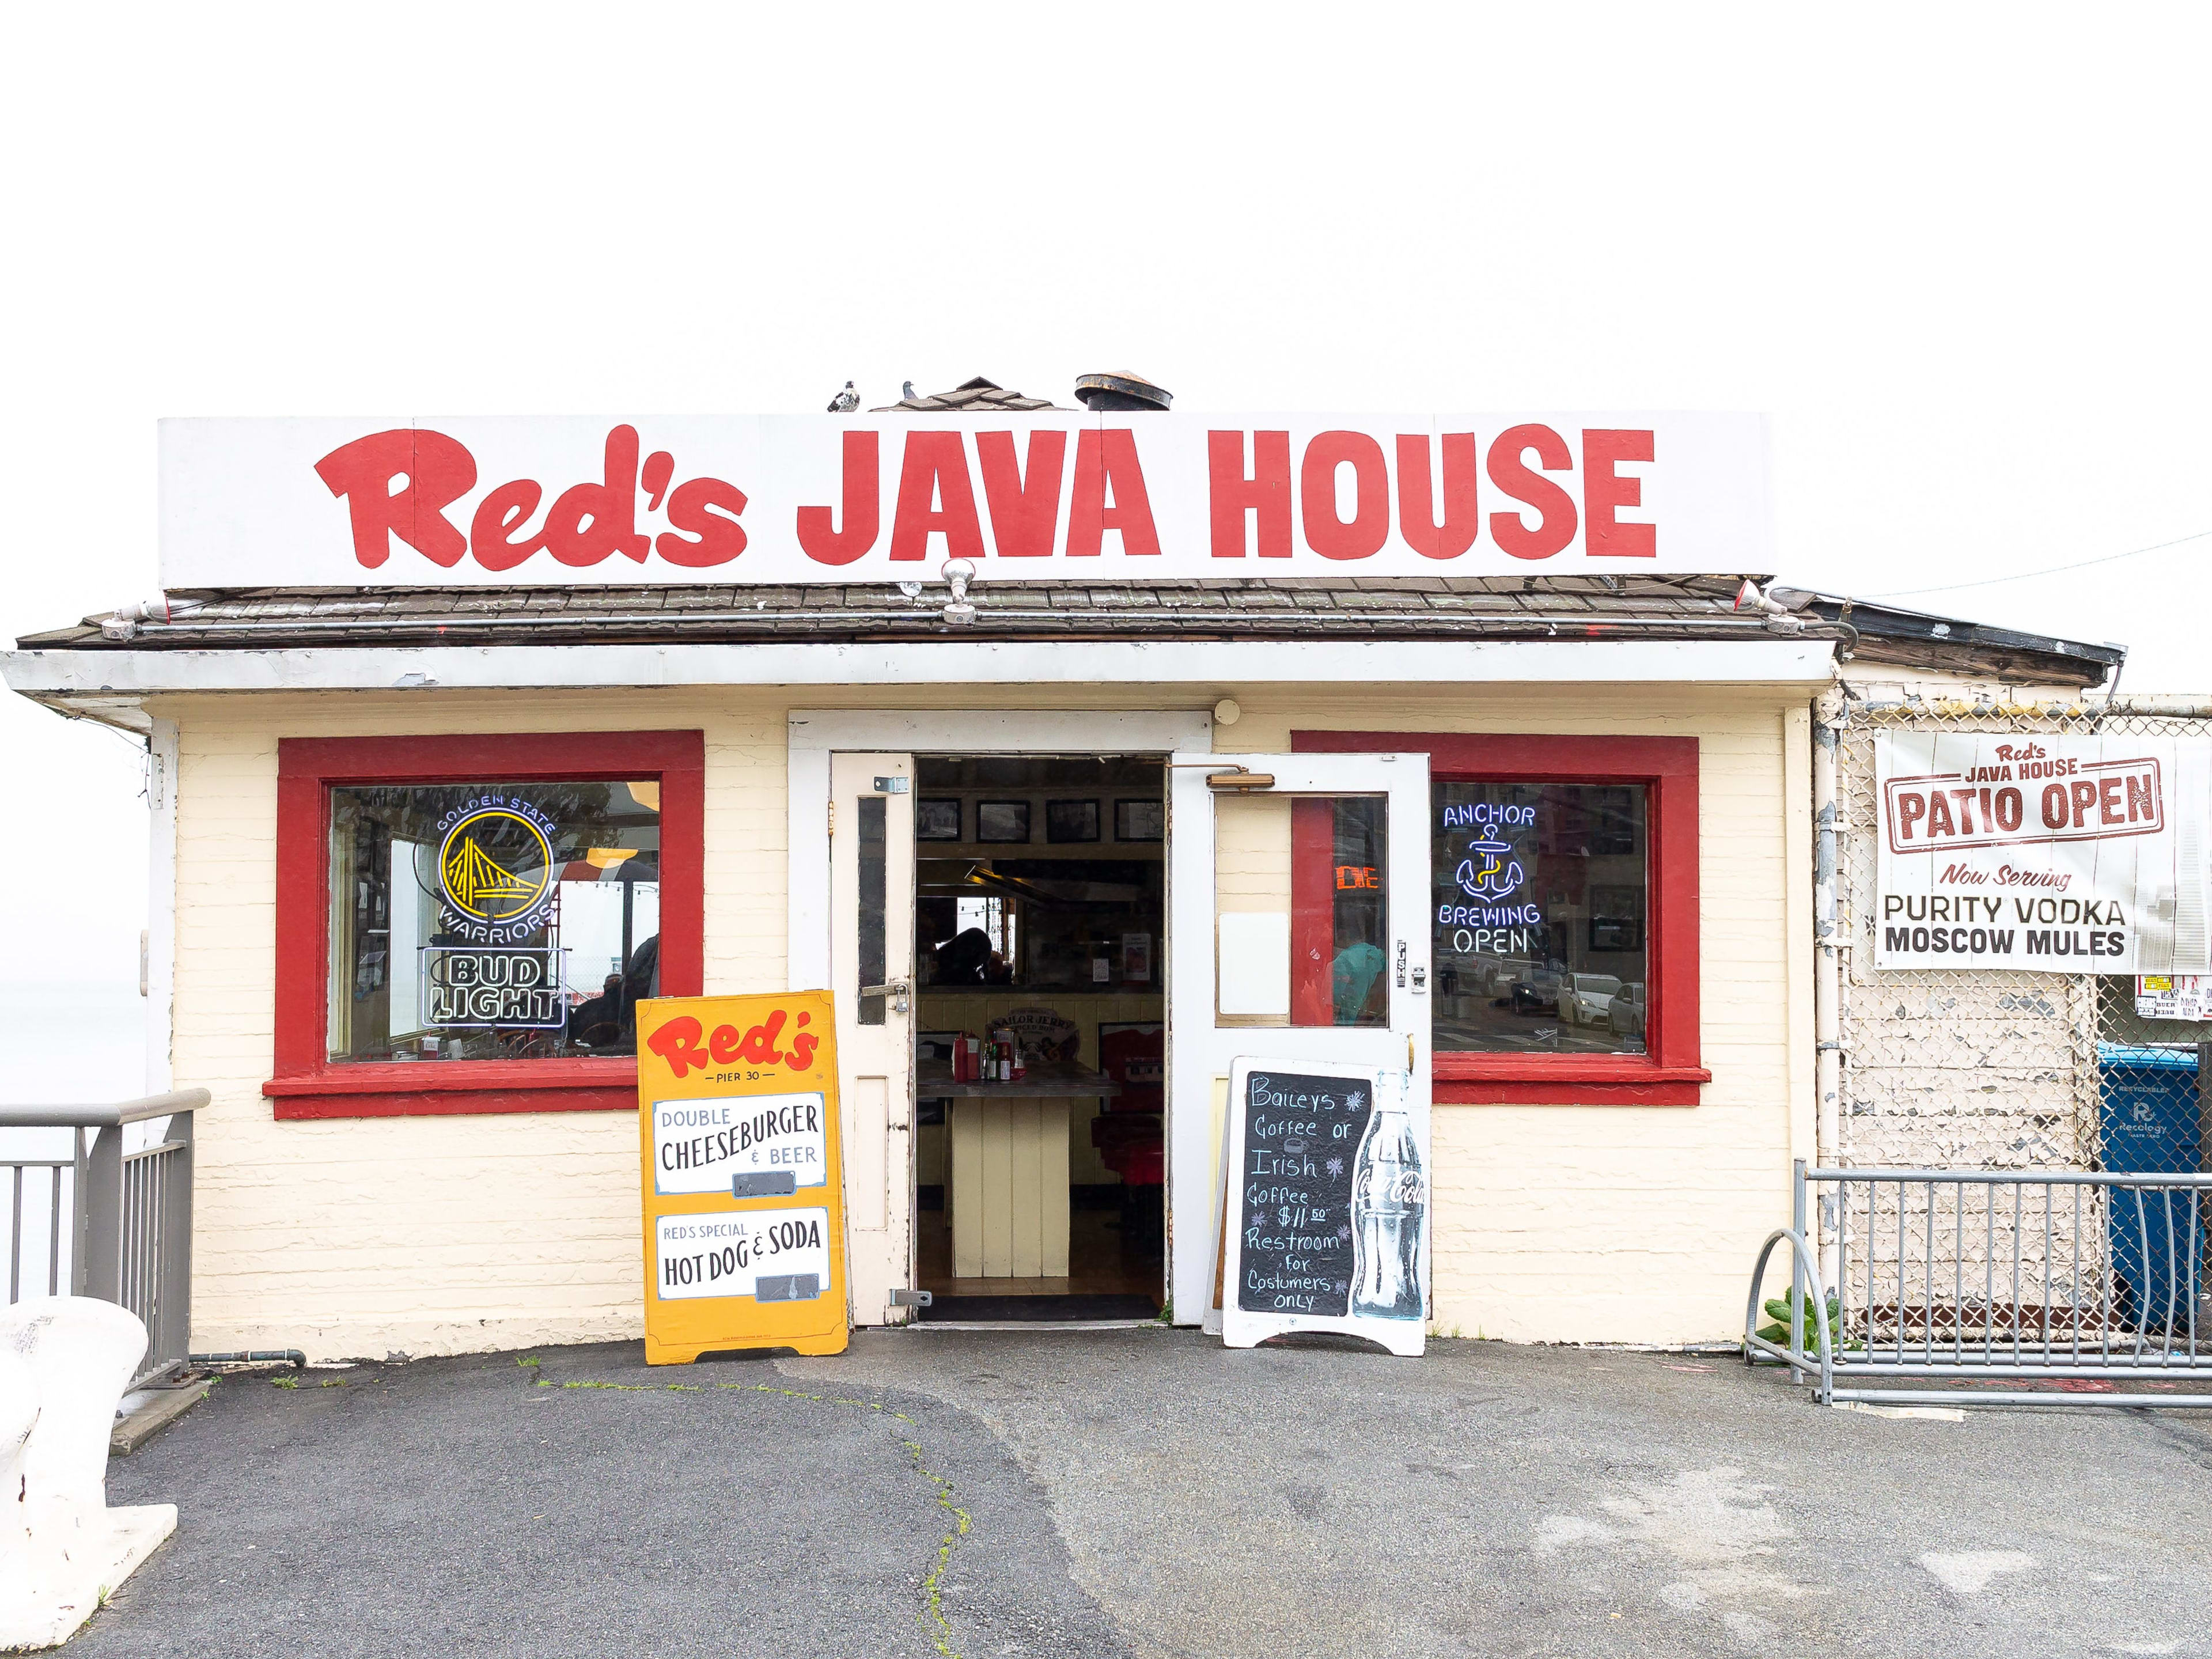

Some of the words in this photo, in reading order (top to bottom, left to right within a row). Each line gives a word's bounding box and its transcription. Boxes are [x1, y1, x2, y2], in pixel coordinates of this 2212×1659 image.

[314, 424, 748, 571] Red's
[797, 430, 1161, 565] JAVA
[1208, 424, 1656, 559] HOUSE
[1995, 742, 2046, 762] Red's
[1965, 764, 2012, 782] JAVA
[2019, 758, 2077, 781] HOUSE
[437, 795, 503, 831] GOLDEN
[510, 798, 556, 834] STATE
[1444, 804, 1535, 827] ANCHOR
[1899, 786, 2023, 839] PATIO
[2041, 774, 2154, 830] OPEN
[1940, 863, 1990, 886] Now
[1994, 865, 2071, 891] Serving
[1440, 903, 1540, 926] BREWING
[1885, 895, 2002, 923] PURITY
[2013, 897, 2126, 926] VODKA
[439, 904, 555, 944] WARRIORS
[1454, 929, 1527, 953] OPEN
[1885, 927, 2014, 954] MOSCOW
[2027, 930, 2125, 956] MULES
[449, 955, 540, 987] BUD
[1397, 943, 1406, 978] PUSH
[430, 987, 558, 1020] LIGHT
[994, 1015, 1033, 1027] SAILOR
[1036, 1016, 1071, 1029] JERRY
[647, 1009, 819, 1078] Red's
[717, 1073, 740, 1083] PIER
[746, 1071, 759, 1080] 30
[662, 1108, 730, 1127] DOUBLE
[2120, 1122, 2167, 1134] Recology
[662, 1105, 818, 1171] CHEESEBURGER
[1333, 1124, 1351, 1139] or
[751, 1150, 759, 1165] &
[771, 1147, 817, 1164] BEER
[1251, 1150, 1317, 1177] Irish
[664, 1225, 696, 1240] RED'S
[699, 1224, 748, 1237] SPECIAL
[1245, 1227, 1340, 1250] Restroom
[665, 1254, 703, 1285] HOT
[710, 1240, 748, 1281] DOG
[753, 1232, 763, 1260] &
[769, 1221, 820, 1255] SODA
[1248, 1270, 1331, 1291] Costumers
